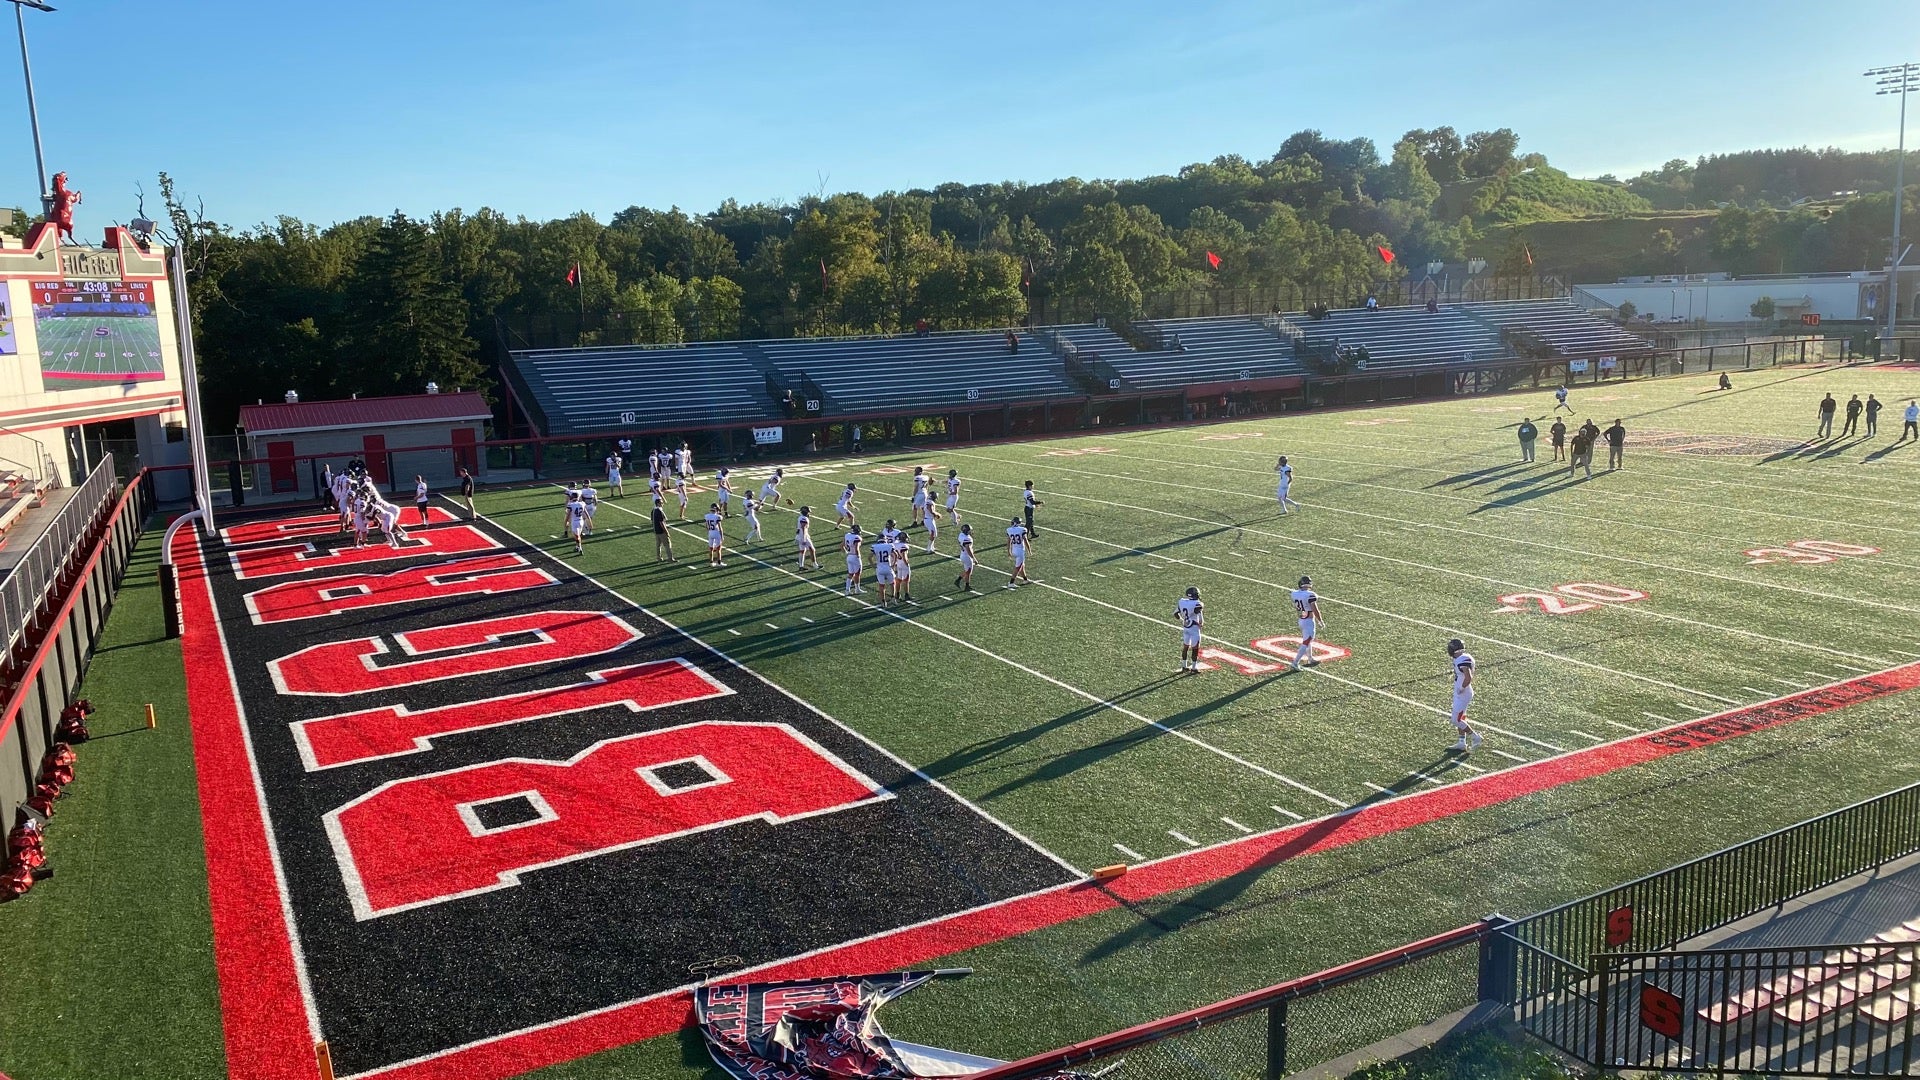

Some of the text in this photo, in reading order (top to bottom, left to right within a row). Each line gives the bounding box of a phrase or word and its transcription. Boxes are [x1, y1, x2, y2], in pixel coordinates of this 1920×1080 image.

[83, 281, 108, 292] 43:08
[44, 293, 51, 303] 0
[139, 292, 145, 302] 0
[1803, 314, 1819, 325] 40
[1240, 370, 1249, 379] 50
[1110, 379, 1120, 389] 40
[967, 389, 979, 399] 30
[807, 401, 819, 411] 20
[622, 412, 635, 423] 10
[574, 507, 583, 517] 42
[706, 519, 715, 531] 15
[1010, 534, 1022, 545] 33
[879, 550, 889, 563] 12
[1741, 539, 1882, 564] 30
[218, 506, 563, 626] RED
[1496, 581, 1651, 616] 20
[1294, 599, 1305, 612] 31
[1198, 634, 1352, 676] 10
[266, 609, 898, 922] BIG
[1607, 906, 1632, 946] S
[1640, 984, 1682, 1037] S
